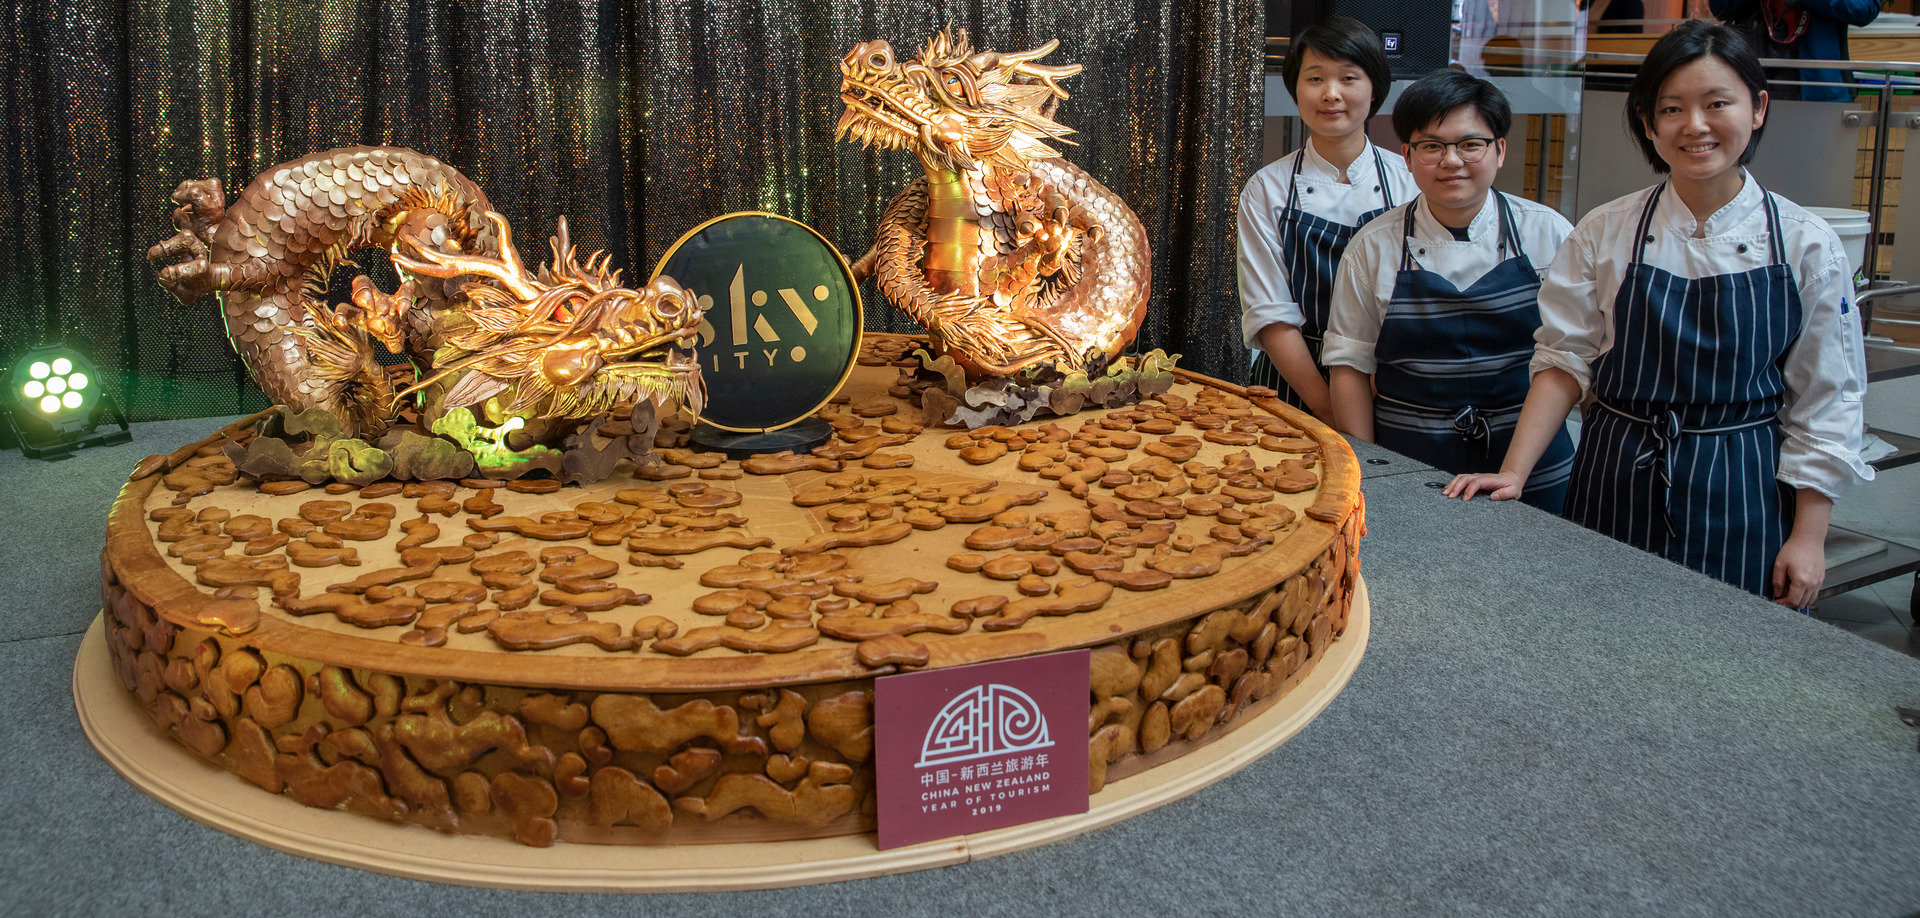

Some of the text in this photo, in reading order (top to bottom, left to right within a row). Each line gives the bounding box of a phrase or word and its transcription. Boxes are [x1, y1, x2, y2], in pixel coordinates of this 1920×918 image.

[921, 772, 1050, 800] CHINA NEW ZEALAND
[922, 784, 1050, 813] YEAR OF TOURISM
[972, 804, 1002, 816] 2019
